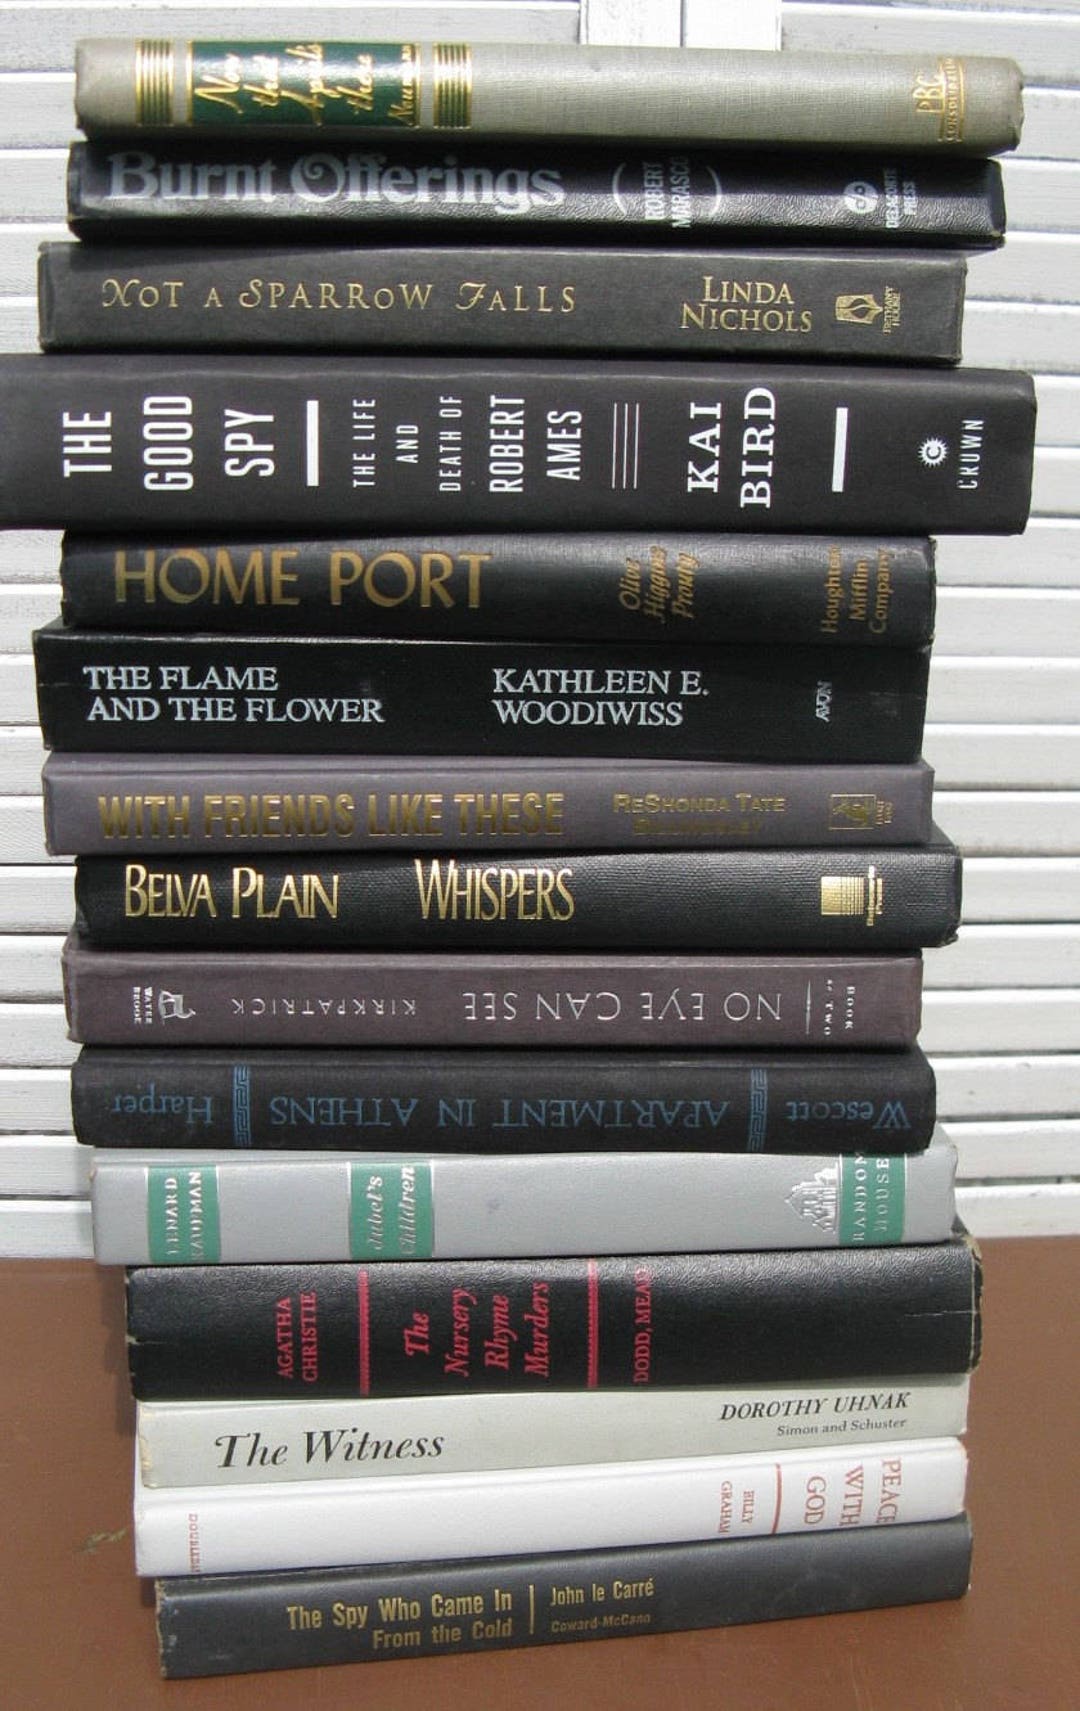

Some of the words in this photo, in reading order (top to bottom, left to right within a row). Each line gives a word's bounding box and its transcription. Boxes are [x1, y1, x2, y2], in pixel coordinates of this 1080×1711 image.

[106, 150, 276, 200] Burnt
[290, 153, 566, 215] Offerings
[644, 161, 665, 221] ROBERT
[671, 155, 691, 228] MARASCO
[101, 279, 183, 308] NOT
[203, 287, 223, 308] A
[238, 278, 433, 310] SPARROW
[454, 281, 576, 313] FALLS
[702, 275, 794, 304] LINDA
[680, 303, 812, 333] NICHOLS
[353, 398, 375, 440] LIFE
[440, 395, 462, 418] OF
[63, 411, 112, 477] THE
[143, 395, 193, 491] GOOD
[224, 408, 275, 477] SPY
[396, 424, 418, 463] AND
[440, 430, 462, 491] DEATH
[490, 394, 525, 492] ROBERT
[546, 410, 583, 481] AMES
[687, 402, 722, 493] KAI
[740, 387, 776, 508] BIRD
[957, 419, 984, 490] CROWN
[353, 453, 375, 488] THE
[114, 548, 300, 605] HOME
[330, 551, 492, 608] PORT
[618, 558, 641, 610] Olive
[643, 545, 671, 625] Higgins
[671, 553, 700, 620] Prouty
[848, 560, 868, 621] Mifflin
[868, 549, 894, 634] Company
[83, 666, 151, 691] THE
[160, 666, 279, 692] FLAME
[493, 669, 671, 696] KATHLEEN
[682, 671, 709, 696] E.
[87, 697, 160, 722] AND
[168, 697, 237, 722] THE
[246, 698, 385, 723] FLOWER
[493, 699, 683, 726] WOODIWISS
[99, 796, 190, 839] WITH
[203, 795, 355, 838] FRIENDS
[368, 794, 443, 837] LIKE
[453, 792, 564, 837] THESE
[125, 863, 216, 919] BELVA
[231, 866, 339, 919] PLAIN
[414, 858, 576, 921] WHISPERS
[231, 999, 416, 1016] KIRKPATRICK
[464, 992, 516, 1020] SEE
[536, 992, 621, 1021] CAN
[641, 988, 703, 1021] EYE
[723, 992, 782, 1022] NO
[111, 1084, 213, 1125] Harper
[270, 1098, 418, 1127] ATHENS
[437, 1099, 473, 1128] IN
[493, 1100, 730, 1128] APARTMENT
[787, 1100, 912, 1130] Wescott
[874, 1158, 890, 1232] HOUSE
[276, 1297, 294, 1380] AGATHA
[301, 1291, 318, 1383] CHRISTIE
[404, 1310, 431, 1358] The
[444, 1287, 477, 1378] Nursery
[485, 1294, 518, 1371] Rhyme
[524, 1281, 549, 1378] Murders
[633, 1327, 653, 1383] DODD,
[720, 1398, 828, 1421] DOROTHY
[834, 1391, 911, 1413] UHNAK
[777, 1424, 819, 1437] Simon
[822, 1421, 847, 1434] and
[851, 1418, 907, 1432] Schuster
[214, 1432, 288, 1468] The
[302, 1427, 445, 1464] Witness
[719, 1480, 733, 1533] GRAHAM
[741, 1490, 755, 1524] BILLY
[804, 1475, 827, 1526] GOD
[839, 1464, 864, 1527] WITH
[875, 1458, 902, 1525] PEACE
[287, 1605, 322, 1631] The
[332, 1602, 368, 1629] Spy
[378, 1596, 421, 1622] Who
[431, 1593, 484, 1618] Came
[495, 1588, 512, 1611] In
[550, 1586, 584, 1607] John
[592, 1583, 605, 1602] le
[612, 1577, 655, 1599] Carré
[373, 1628, 421, 1650] From
[431, 1623, 461, 1644] the
[472, 1618, 512, 1640] Cold
